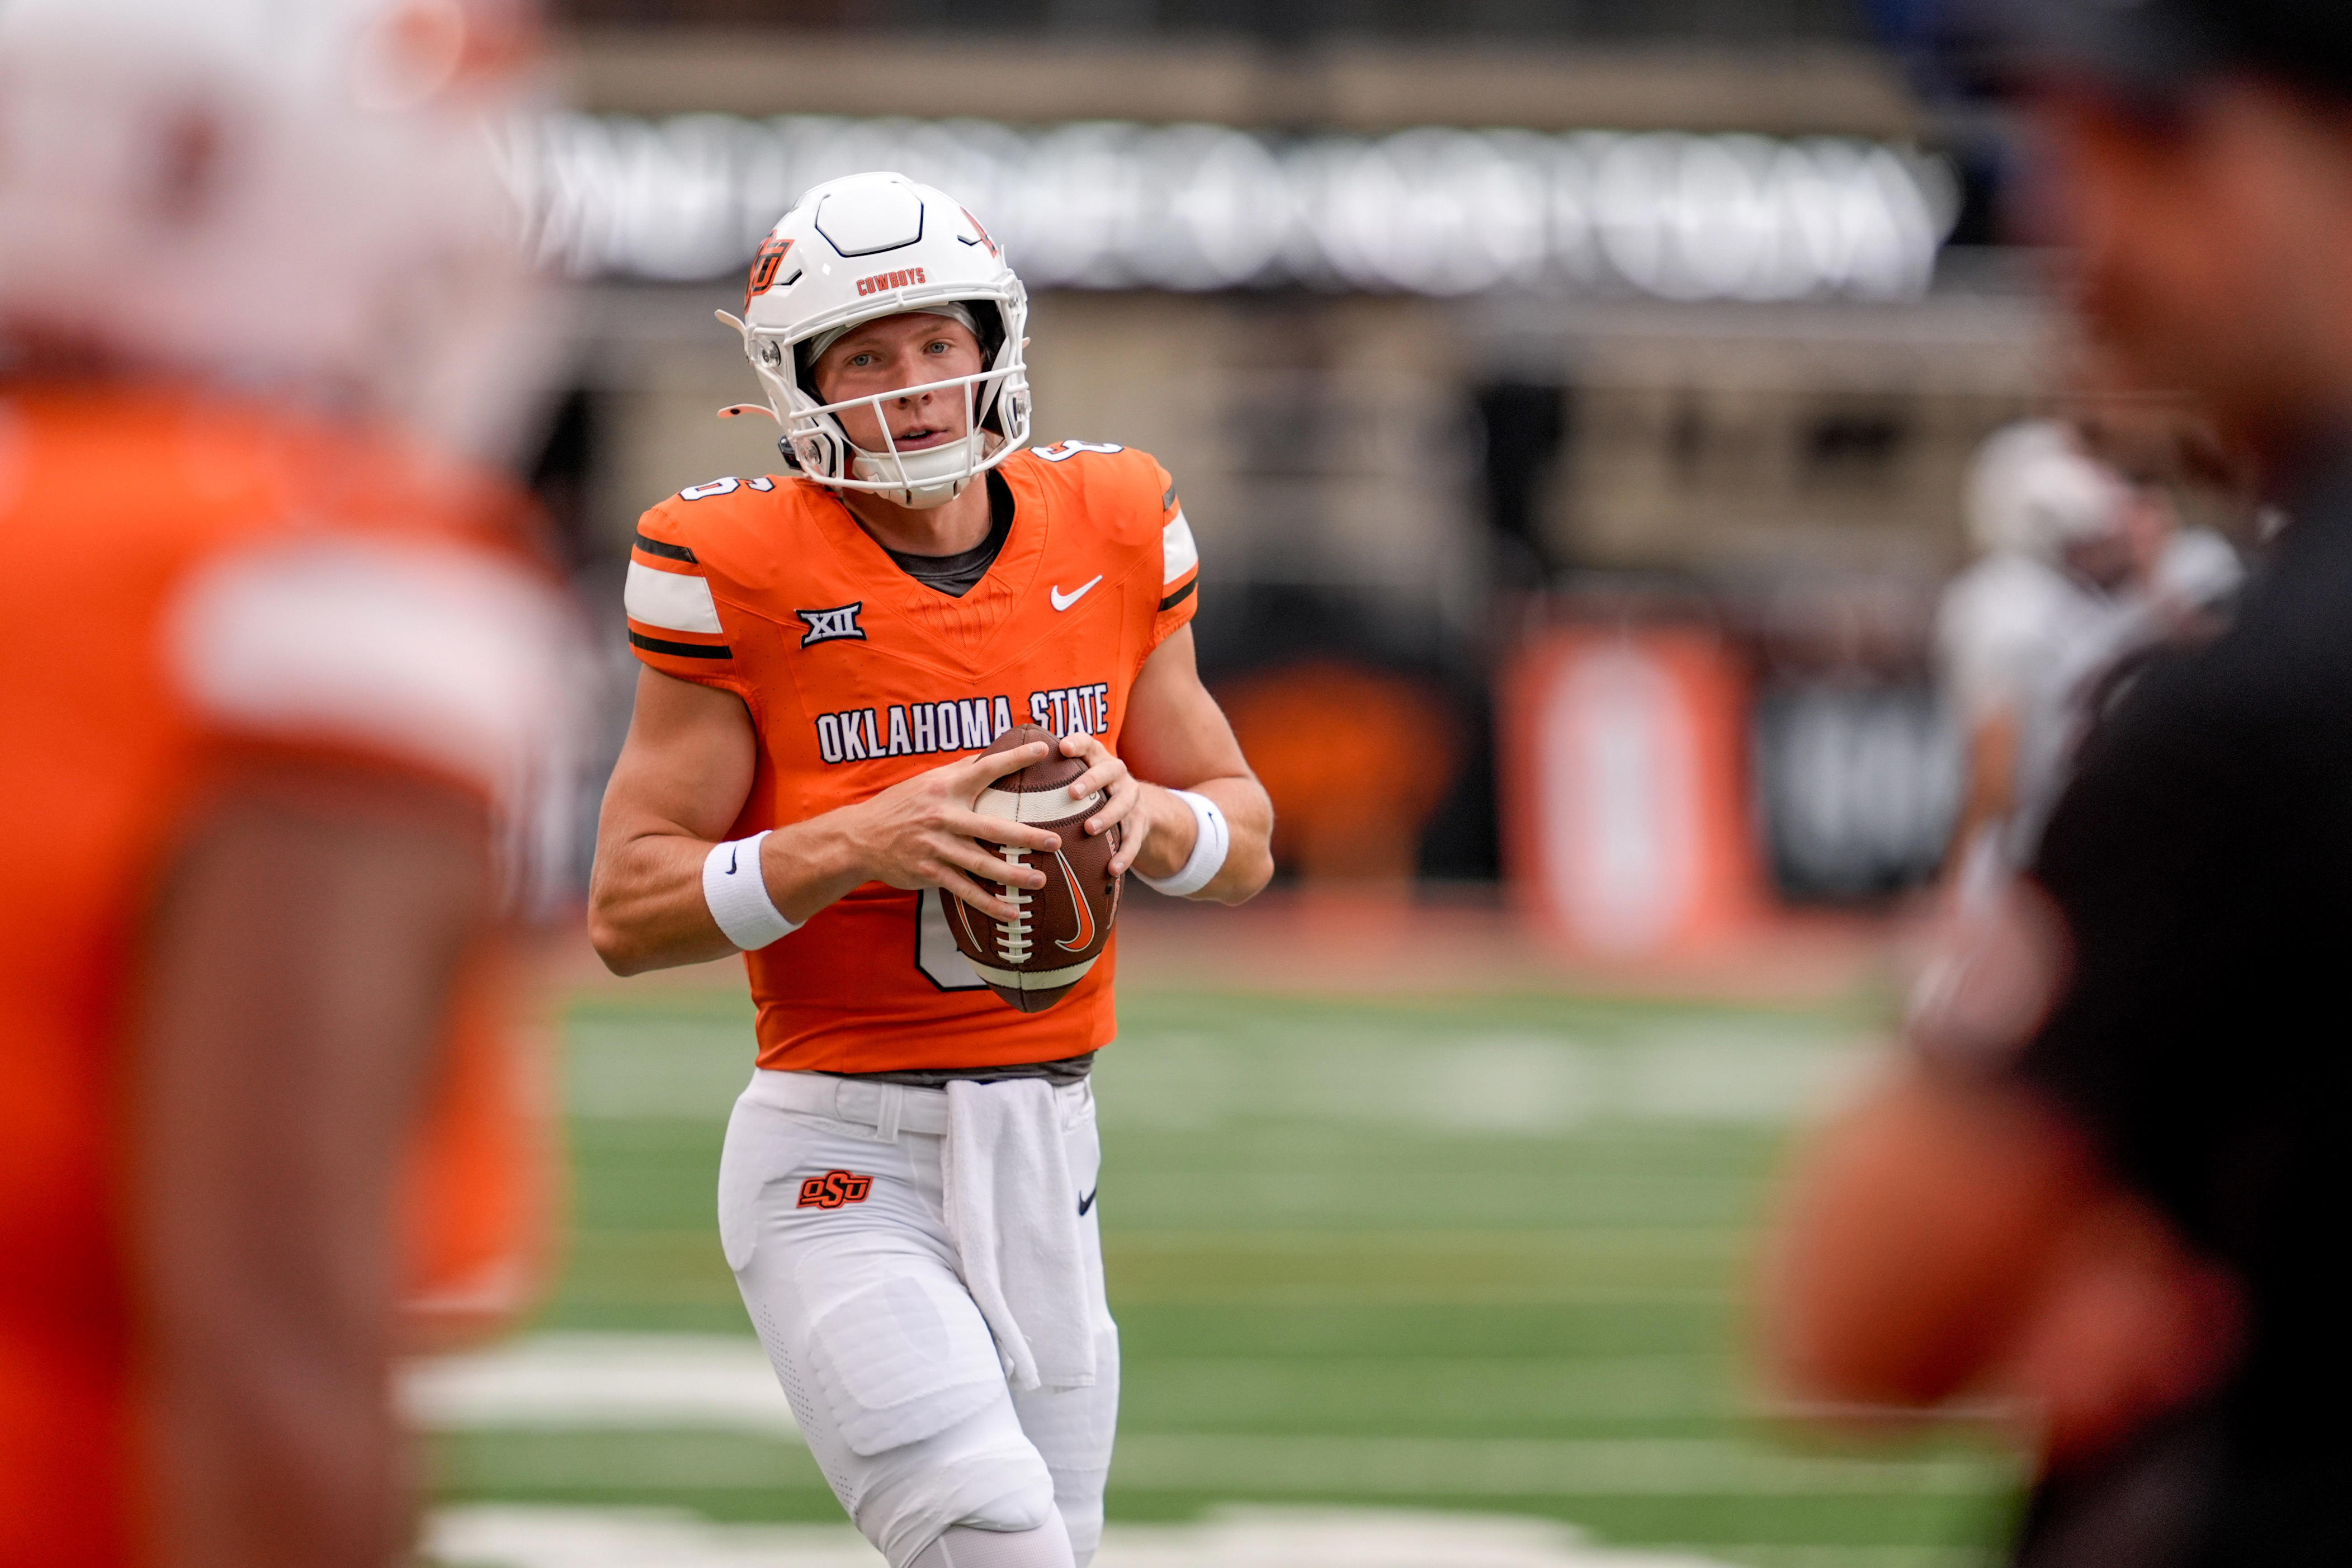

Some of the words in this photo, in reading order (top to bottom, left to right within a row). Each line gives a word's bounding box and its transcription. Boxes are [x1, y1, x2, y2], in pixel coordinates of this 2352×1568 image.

[856, 267, 927, 296] COWBOYS
[679, 476, 776, 501] 6
[797, 602, 866, 647] XII
[815, 695, 1013, 764] OKLAHOMA
[1028, 683, 1108, 739] STATE
[798, 1170, 872, 1209] OSU
